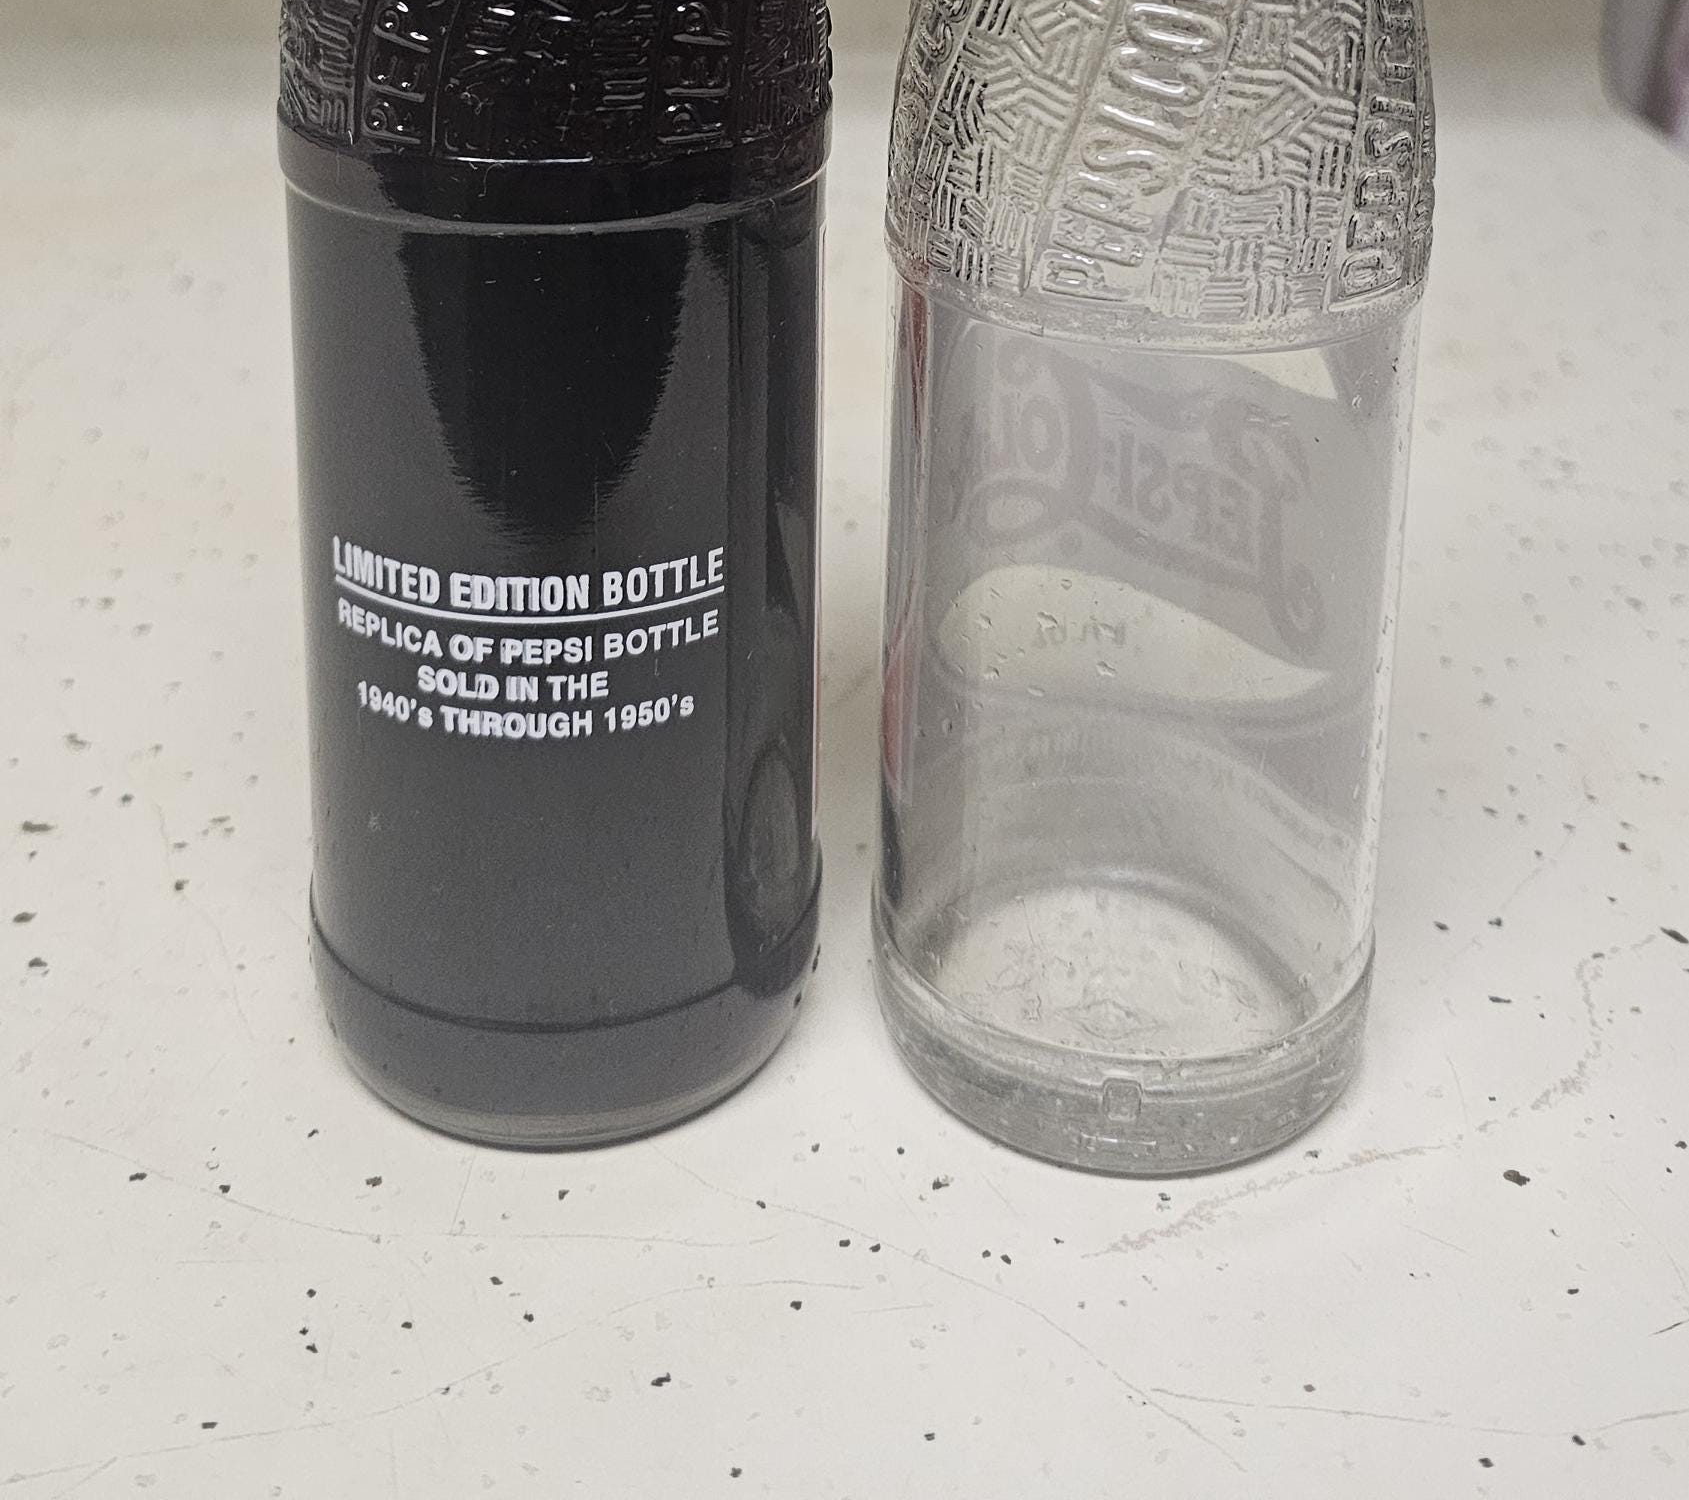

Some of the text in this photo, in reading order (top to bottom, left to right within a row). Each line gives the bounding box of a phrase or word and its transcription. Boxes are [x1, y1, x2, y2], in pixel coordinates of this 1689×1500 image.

[332, 535, 725, 611] LIMITED EDITION BOTTLE
[337, 597, 720, 665] REPLICA OF PEPSI BOTTLE
[358, 681, 695, 739] 1940's THROUGH 1950's
[417, 664, 609, 701] SOLD IN THE
